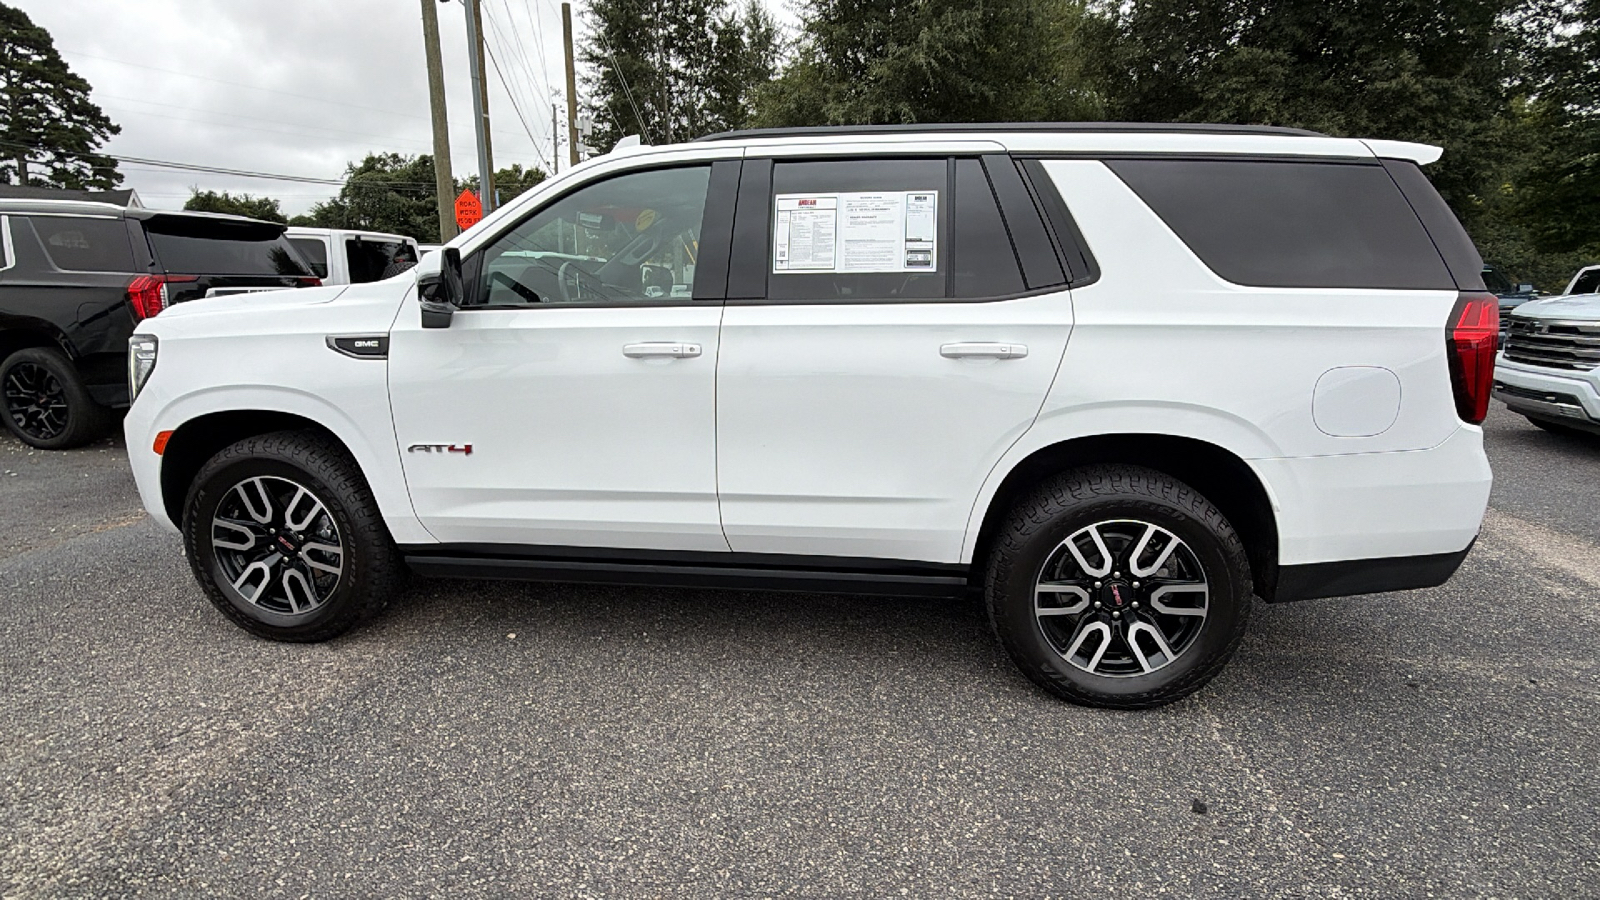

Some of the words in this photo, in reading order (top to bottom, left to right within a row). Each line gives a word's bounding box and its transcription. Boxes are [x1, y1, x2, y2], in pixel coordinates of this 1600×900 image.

[408, 444, 473, 455] AT4
[277, 535, 296, 551] GMC
[1110, 584, 1123, 606] GMC
